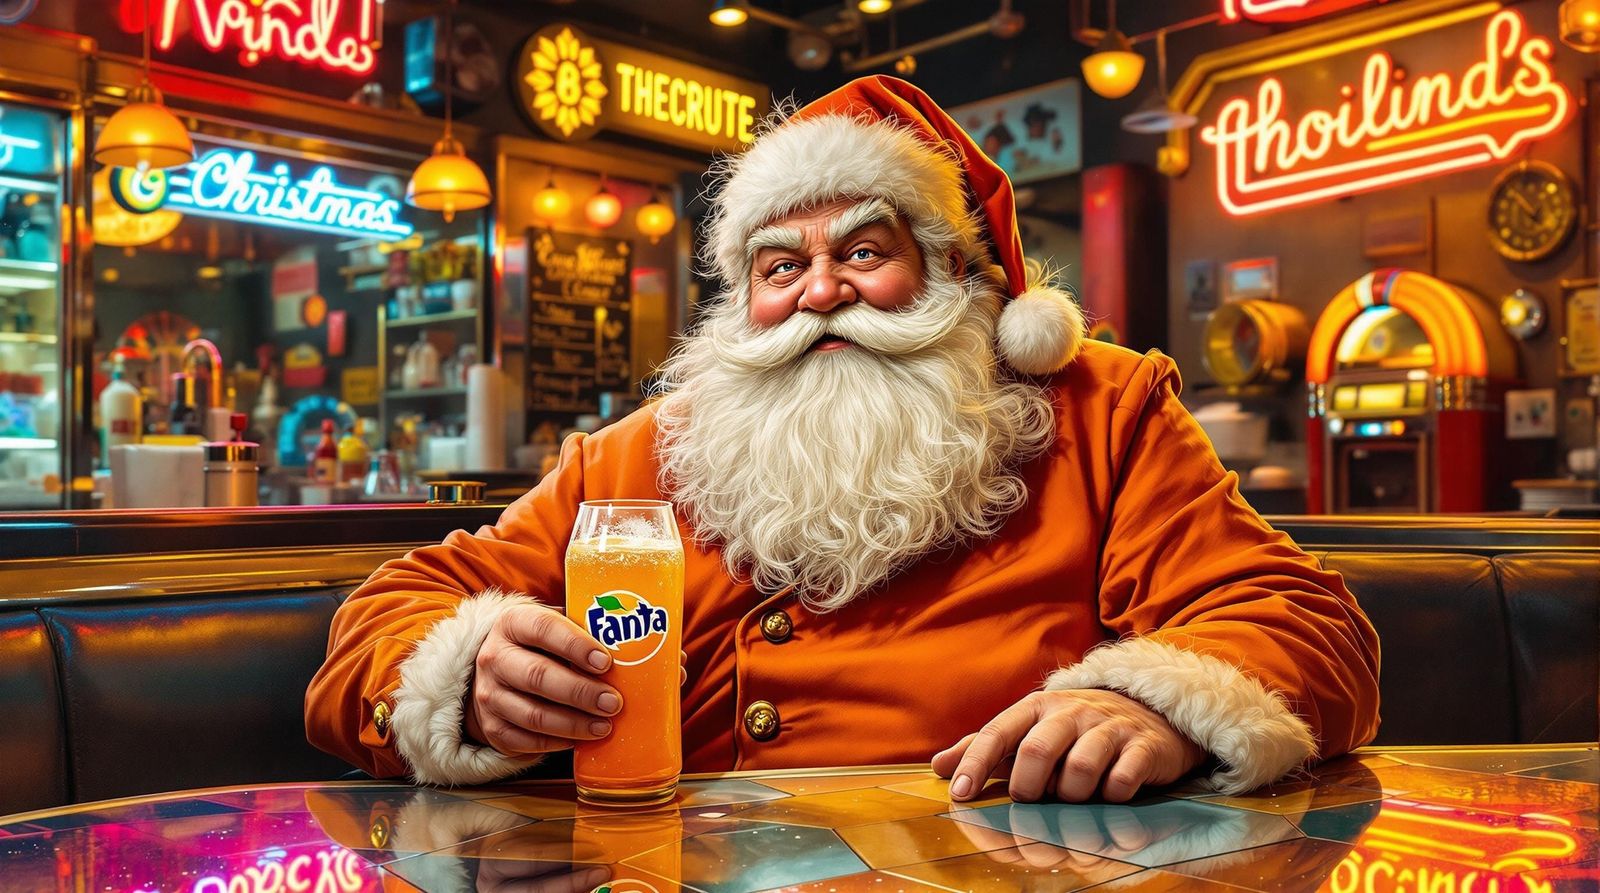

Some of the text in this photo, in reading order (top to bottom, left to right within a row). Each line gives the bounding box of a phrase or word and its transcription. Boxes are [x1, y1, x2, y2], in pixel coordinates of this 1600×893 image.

[616, 62, 756, 143] THECRUTE
[191, 151, 402, 229] Christmas
[588, 602, 667, 646] Fanta
